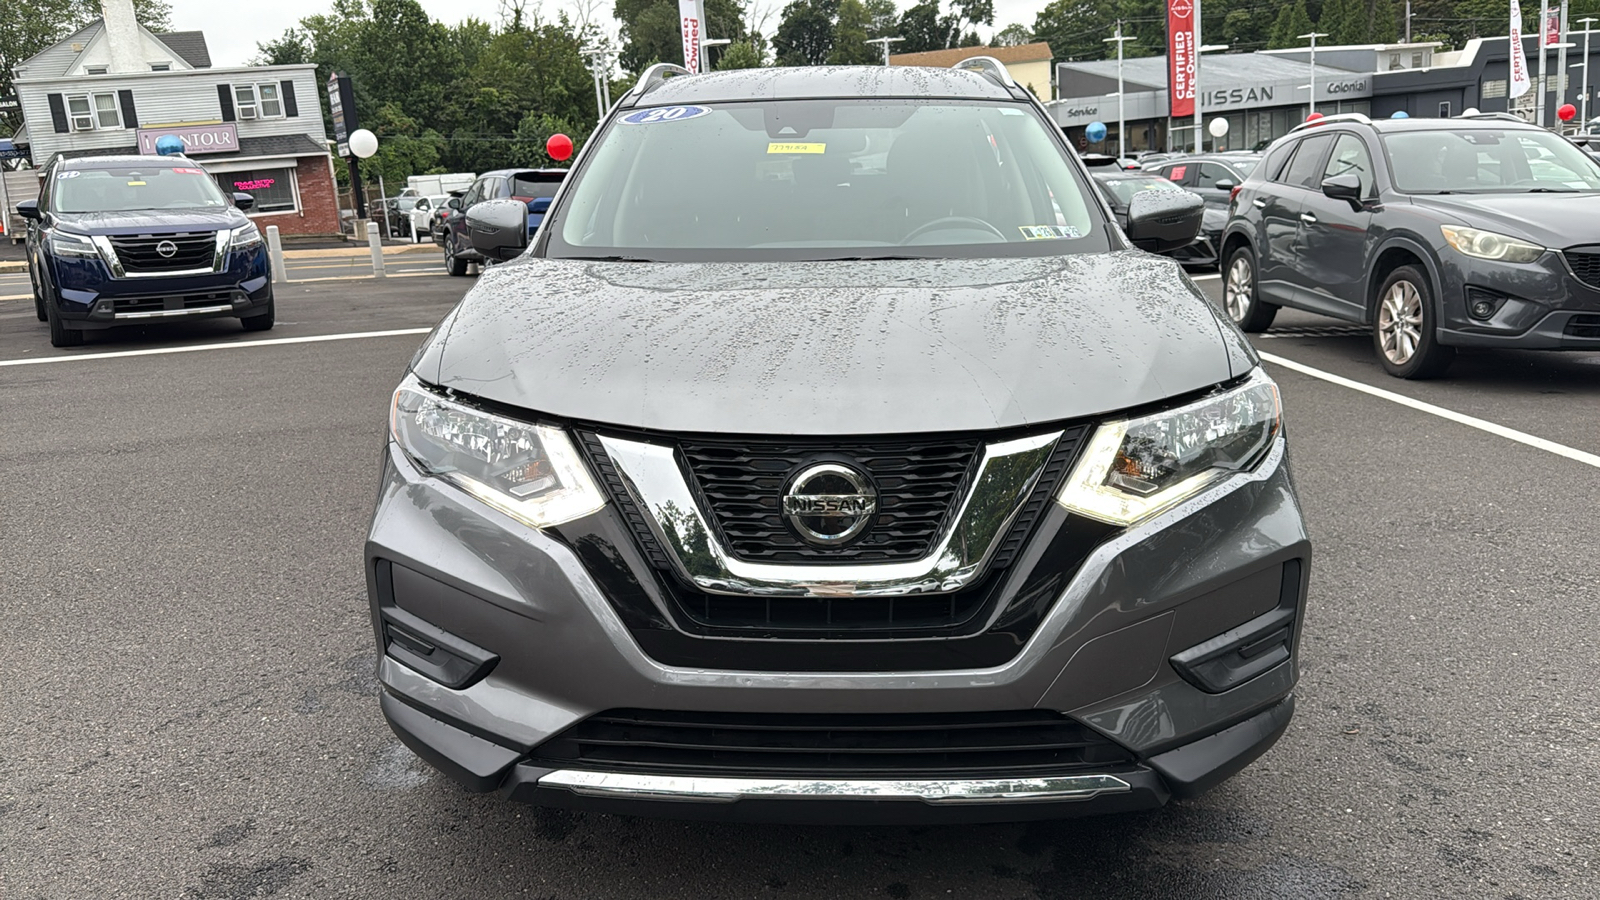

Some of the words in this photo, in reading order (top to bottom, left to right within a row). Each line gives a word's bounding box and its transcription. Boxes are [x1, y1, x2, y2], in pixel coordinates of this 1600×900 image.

[1175, 31, 1186, 100] CERTIFIED
[1327, 80, 1367, 95] Colonial
[640, 106, 686, 122] 20
[1067, 106, 1097, 118] Service
[793, 499, 866, 511] NISSAN
